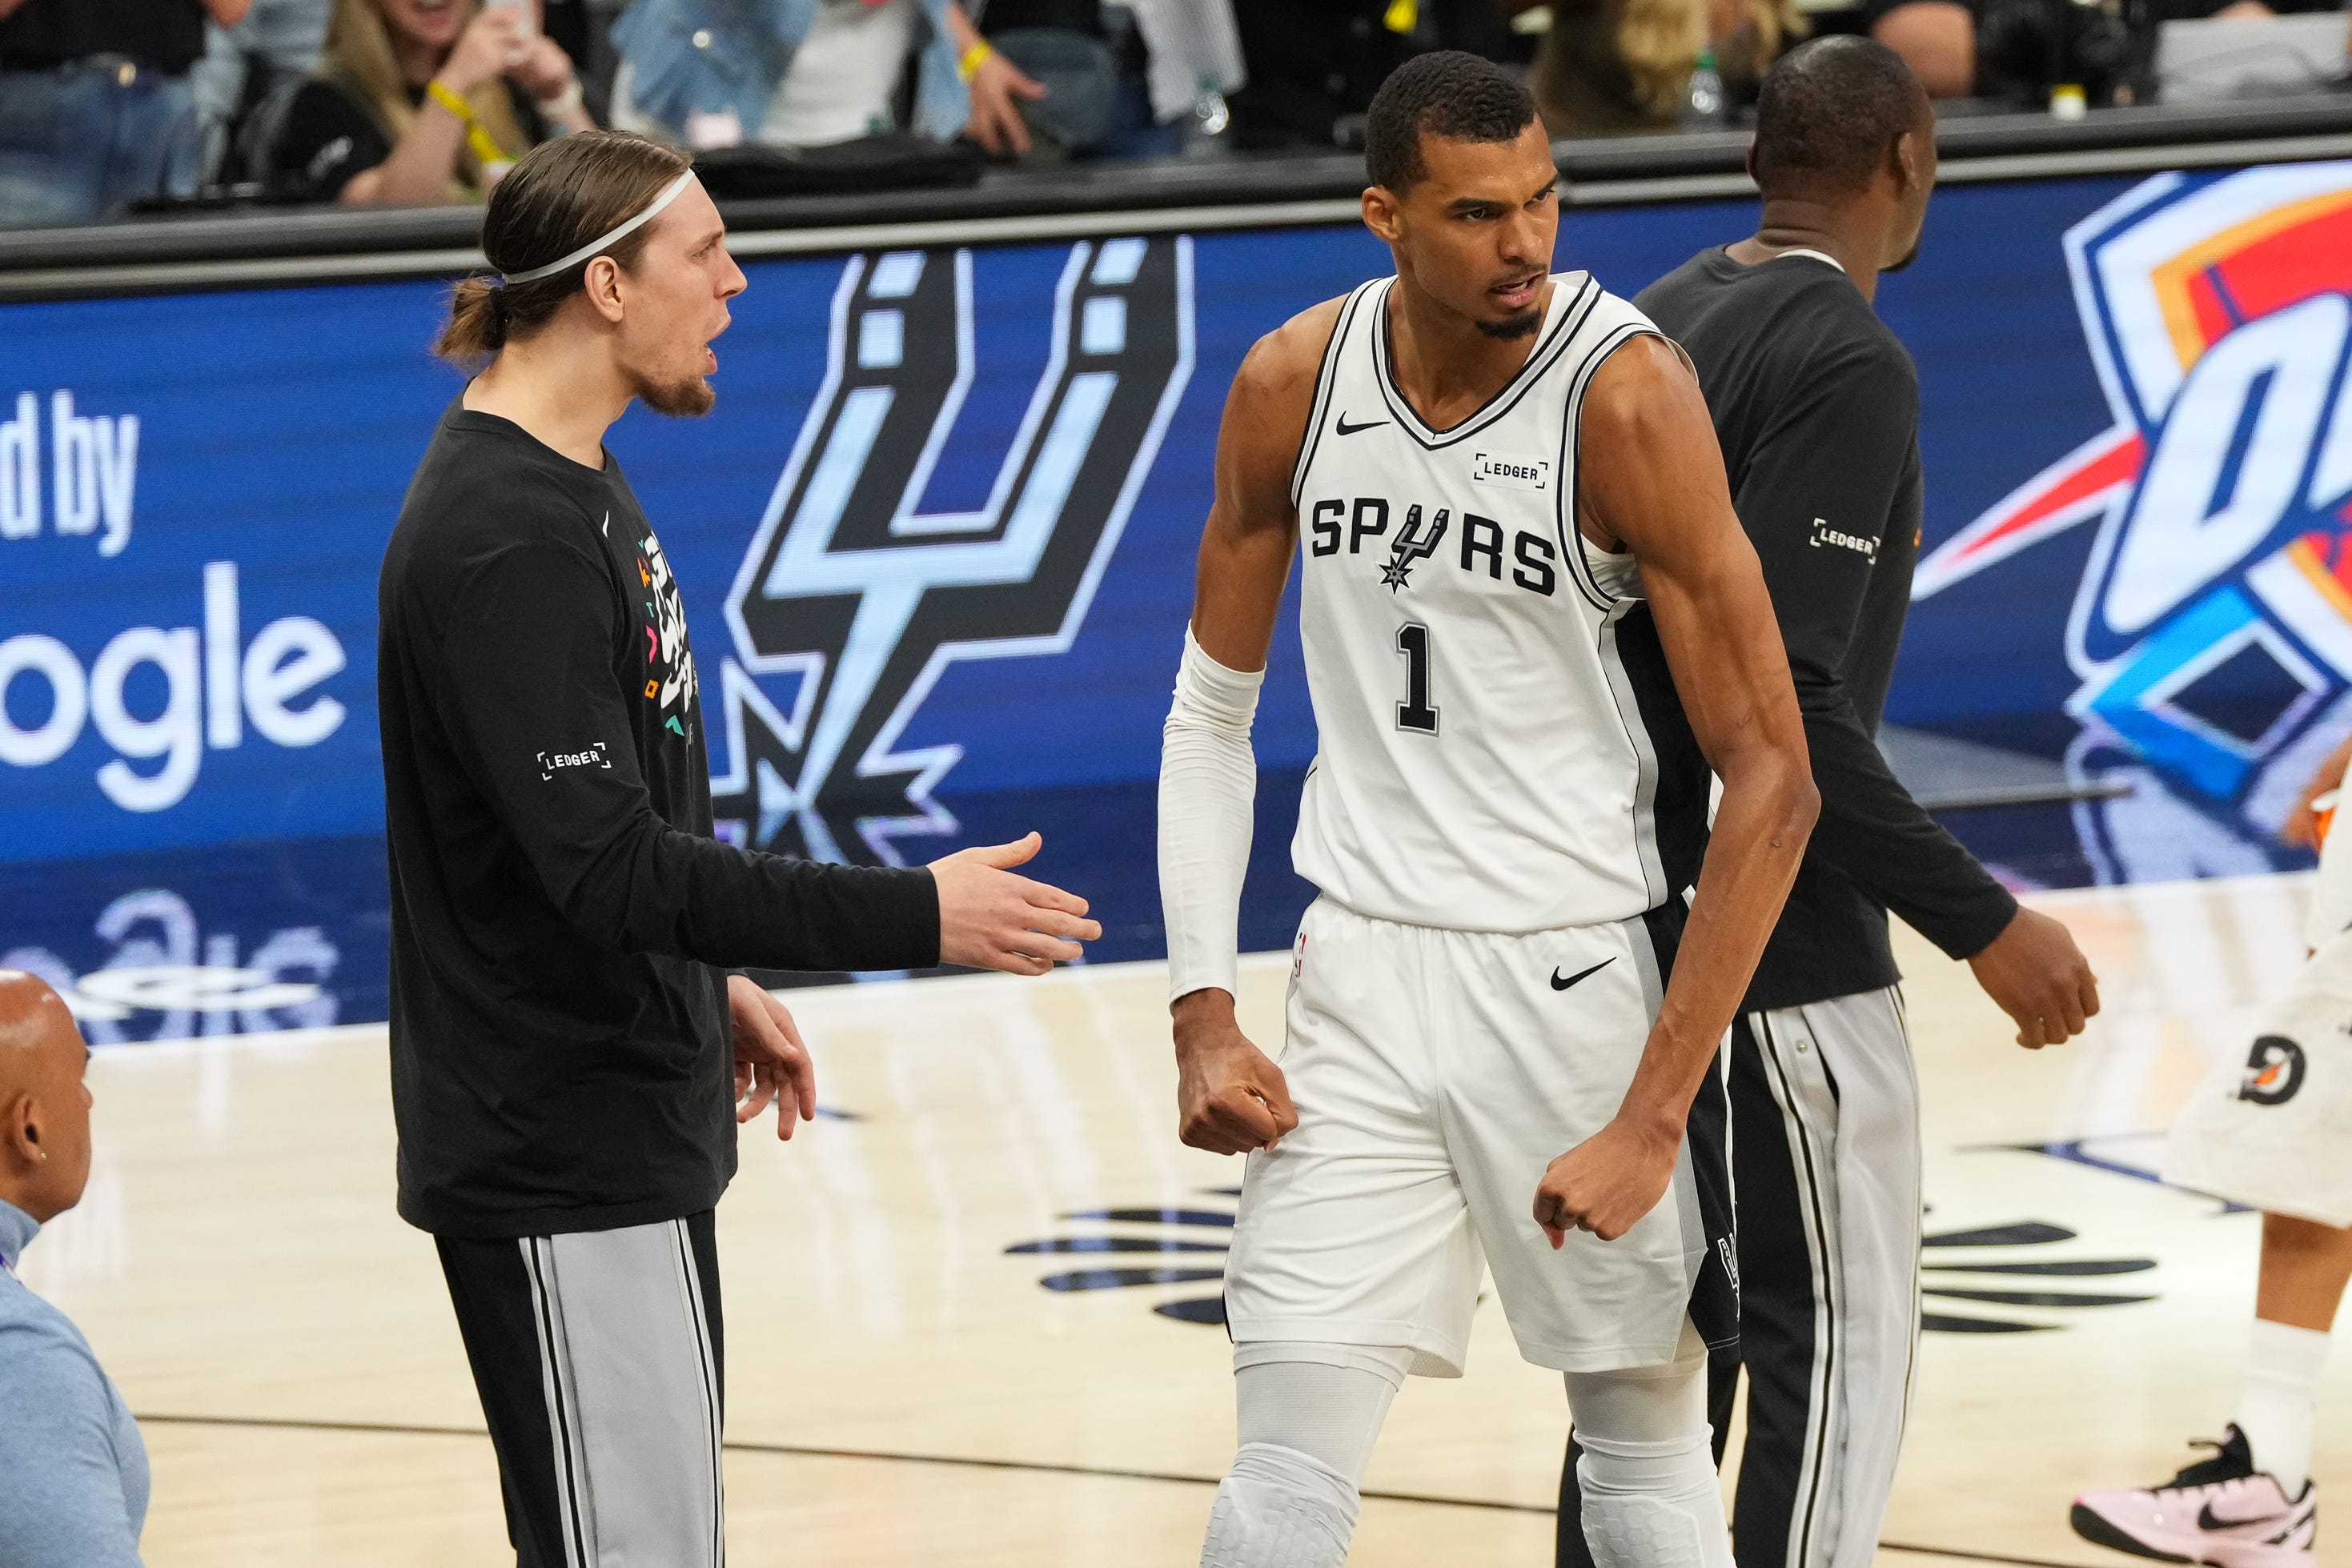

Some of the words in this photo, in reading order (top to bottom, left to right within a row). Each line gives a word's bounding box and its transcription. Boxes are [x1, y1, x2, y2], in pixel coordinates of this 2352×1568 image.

[52, 388, 139, 557] by
[1484, 461, 1539, 480] LEDGER
[1312, 497, 1556, 597] SPURS
[1820, 527, 1873, 555] LEDGER
[1395, 620, 1440, 738] 1
[545, 750, 600, 770] LEDGER
